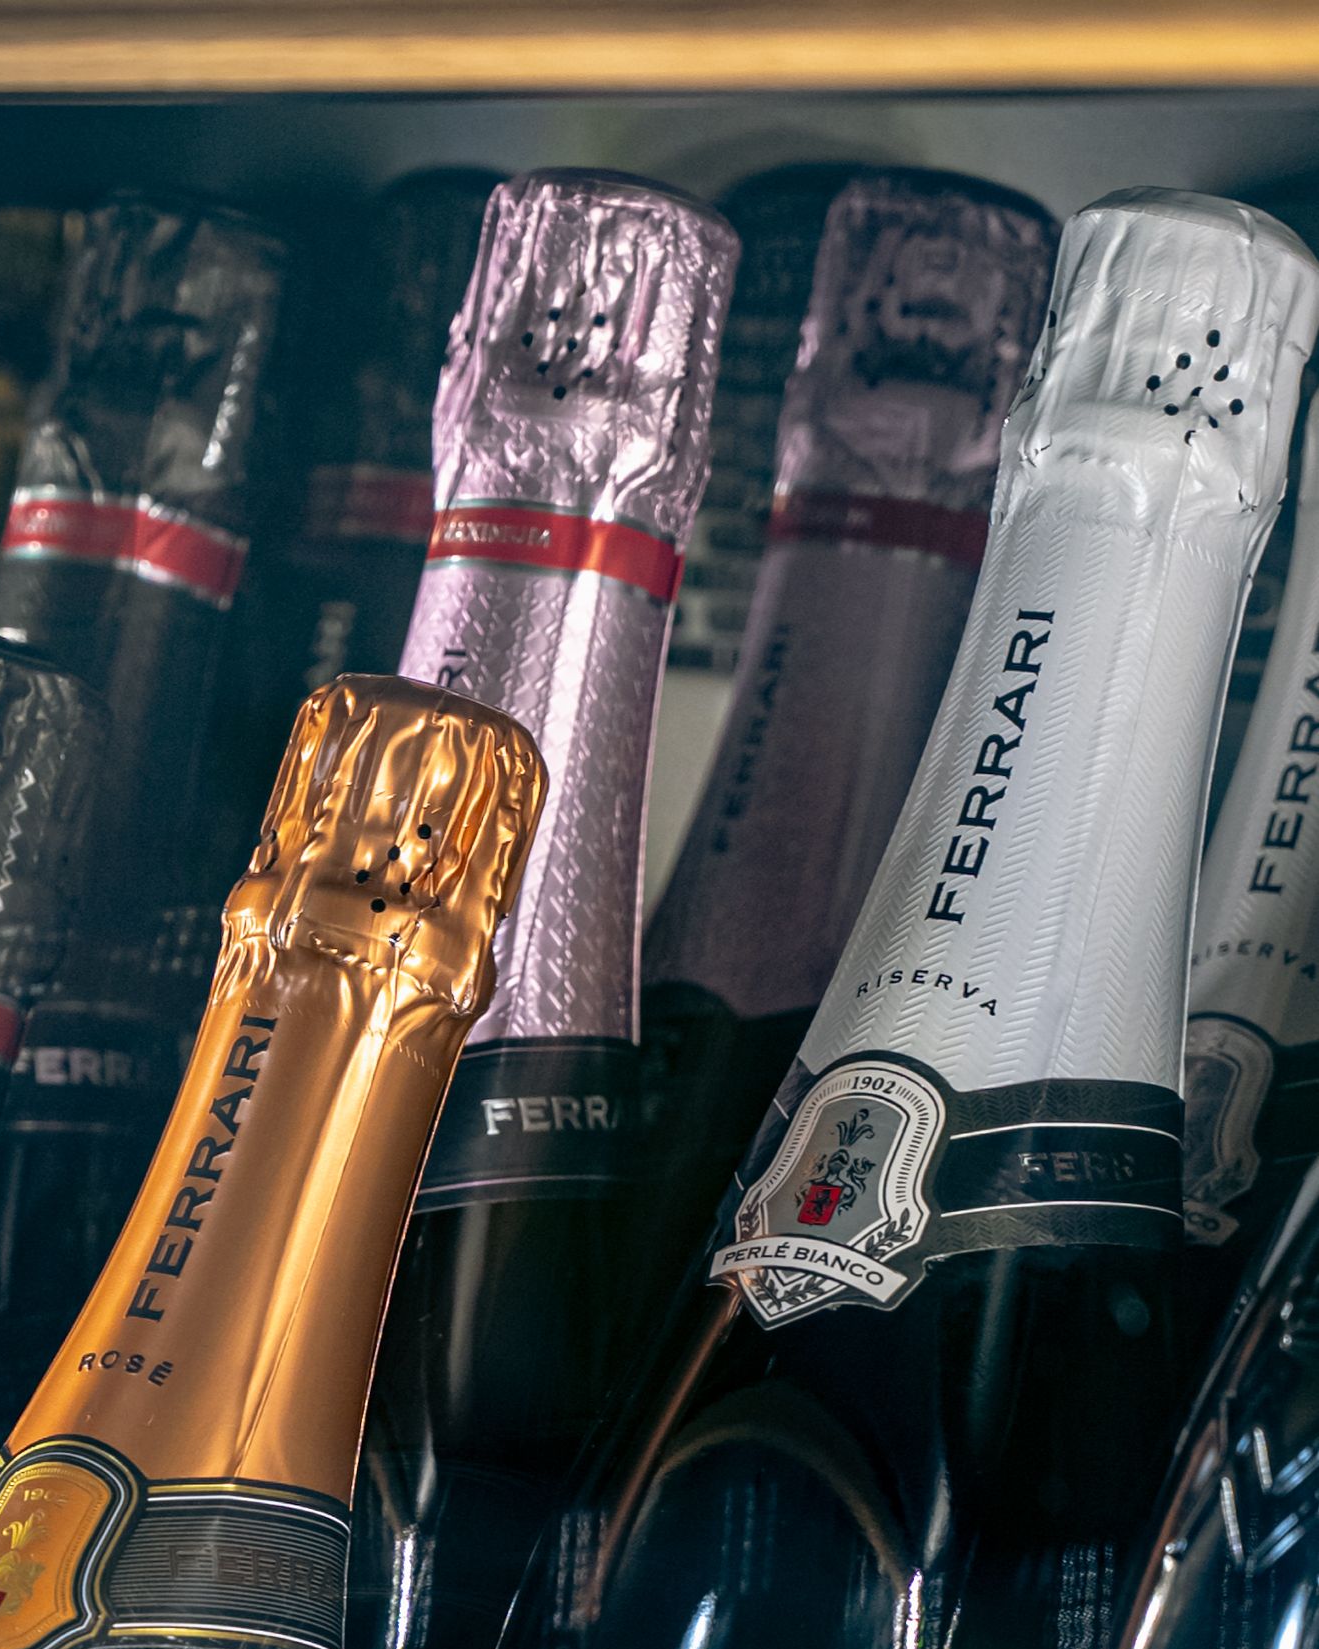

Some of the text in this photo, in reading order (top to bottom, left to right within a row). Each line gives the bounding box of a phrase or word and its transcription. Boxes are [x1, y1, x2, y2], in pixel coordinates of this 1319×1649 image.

[925, 608, 1056, 925] FERRARI
[1247, 620, 1319, 895] FERR
[857, 969, 998, 1016] RISERVA
[850, 1075, 897, 1097] 1902
[125, 1013, 278, 1323] FERRARI
[721, 1243, 885, 1287] PERLÉ BIANCO
[77, 1349, 174, 1388] ROSÉ
